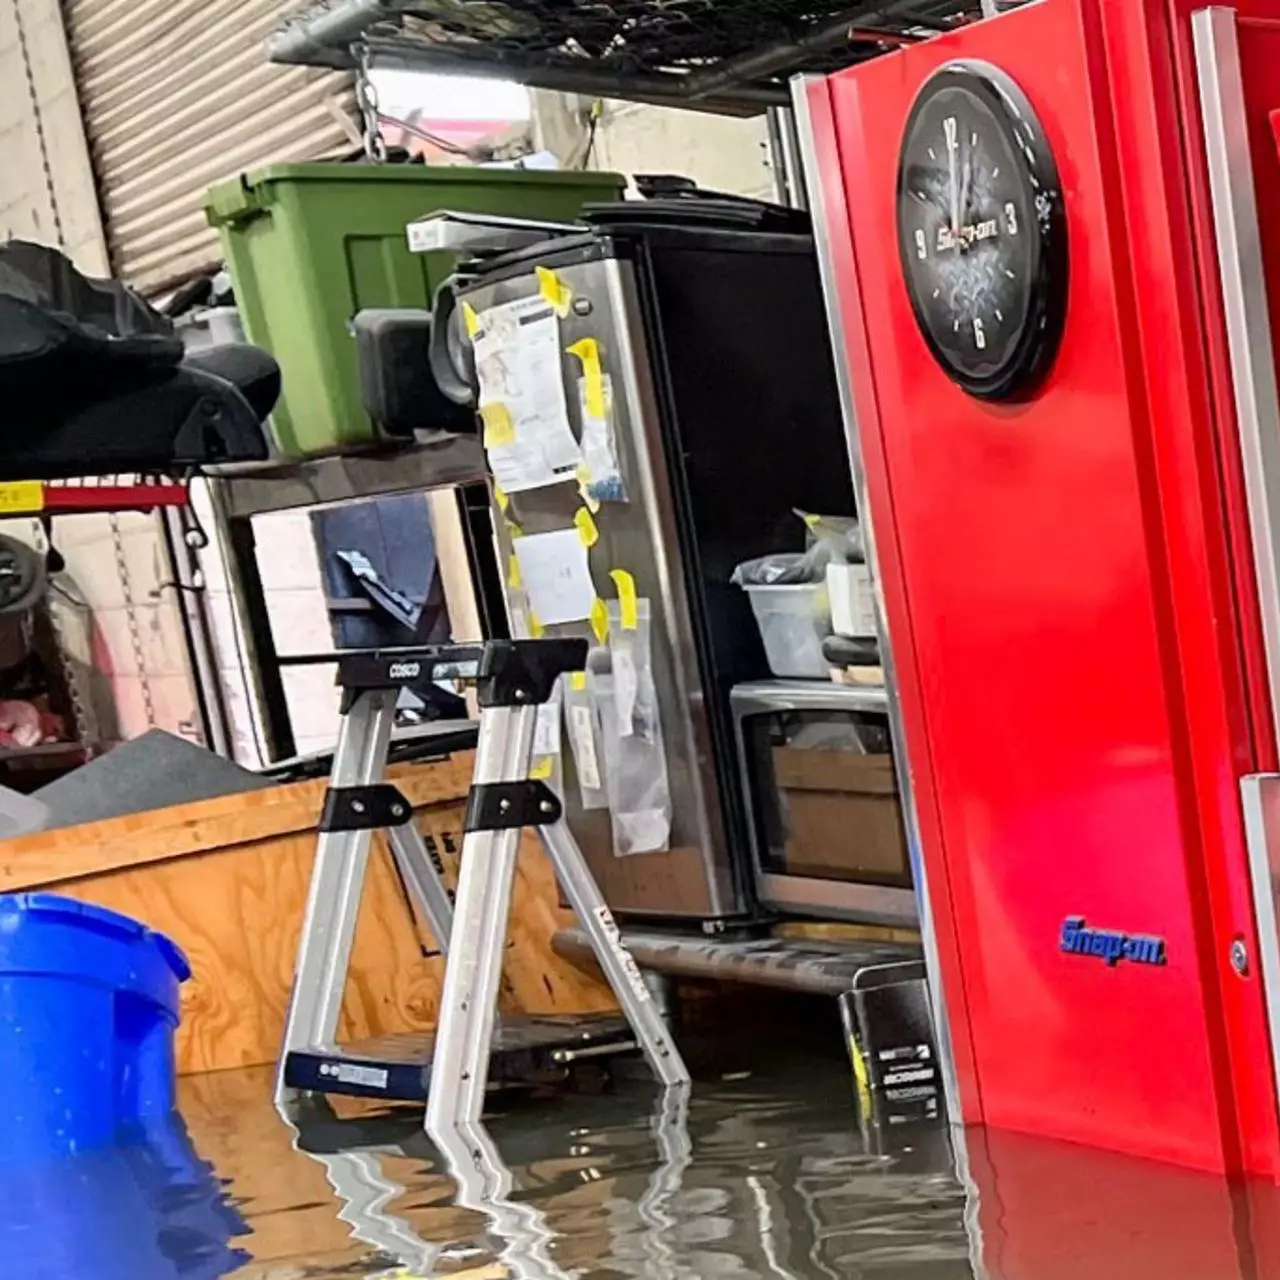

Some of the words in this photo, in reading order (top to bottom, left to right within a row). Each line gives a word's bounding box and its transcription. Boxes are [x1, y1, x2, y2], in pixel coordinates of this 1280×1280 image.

[943, 116, 959, 150] 12
[1004, 203, 1017, 235] 3
[915, 229, 928, 260] 9
[973, 317, 986, 349] 6
[389, 662, 420, 678] COSCO
[1060, 915, 1167, 967] Snap-on
